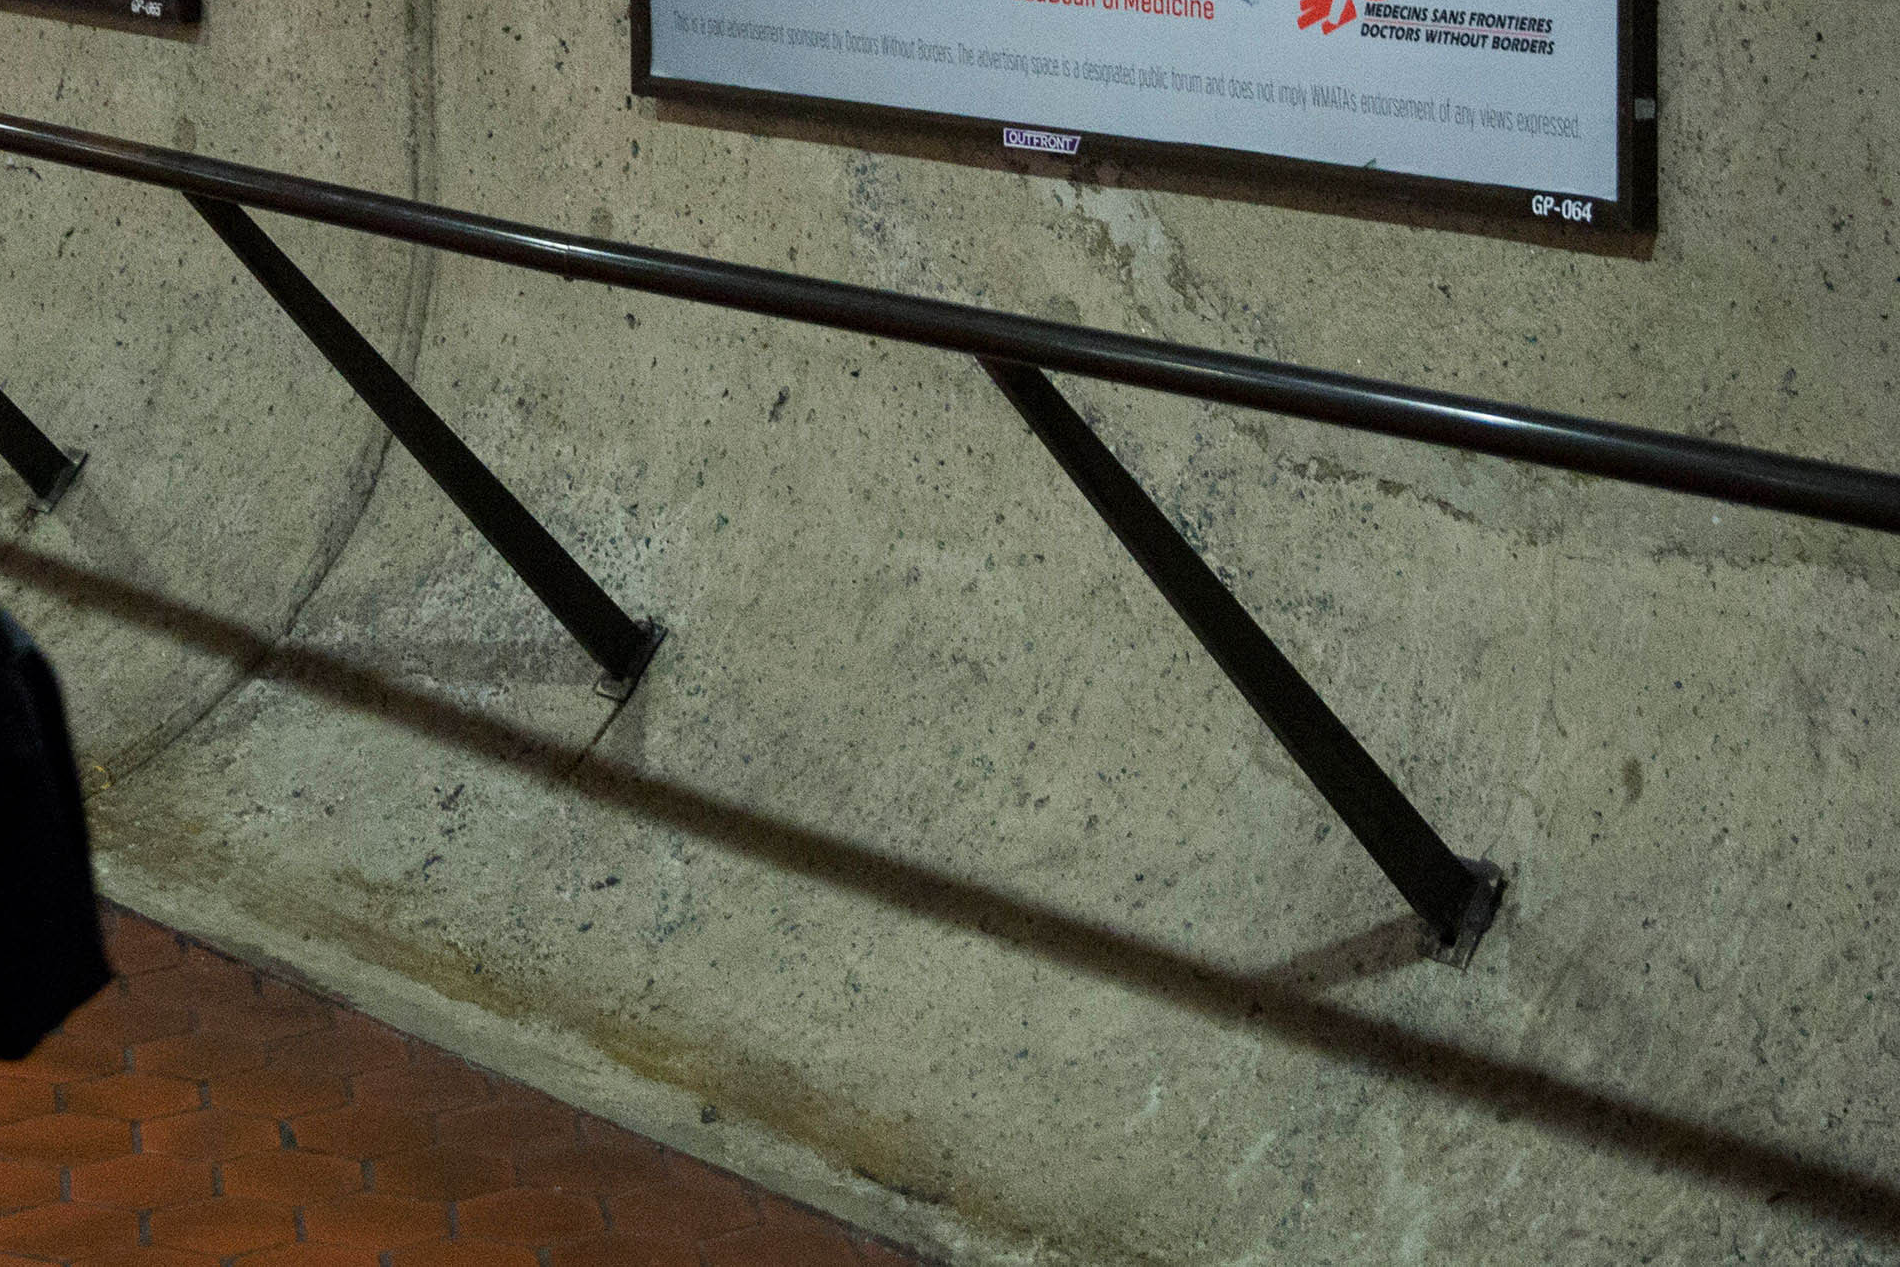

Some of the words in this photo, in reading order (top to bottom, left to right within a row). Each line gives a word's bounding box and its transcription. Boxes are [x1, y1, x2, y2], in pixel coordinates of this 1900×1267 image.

[1364, 2, 1429, 23] MEDECINS
[1431, 8, 1465, 27] SANS
[1468, 10, 1553, 34] FRONTIERES
[1360, 23, 1421, 42] DOCTORS
[1425, 28, 1489, 50] WITHOUT
[1491, 32, 1555, 56] BORDERS
[727, 20, 784, 44] advertisement
[787, 27, 830, 51] sponsored
[832, 29, 843, 54] by
[845, 30, 879, 55] Doctors
[880, 35, 915, 60] Without
[957, 42, 974, 66] The
[977, 46, 1028, 76] advertising
[1031, 55, 1059, 78] space
[1062, 55, 1071, 78] is
[1082, 57, 1136, 87] designated
[1138, 65, 1168, 91] public
[1170, 66, 1202, 93] forum
[1205, 72, 1225, 97] and
[1228, 76, 1254, 100] does
[1256, 79, 1275, 103] not
[1278, 81, 1307, 111] imply
[1360, 93, 1437, 122] endorsement
[1439, 97, 1451, 123] of
[1454, 104, 1475, 131] any
[1479, 104, 1513, 131] views
[1008, 130, 1074, 152] OUTFRONT
[1531, 194, 1593, 223] GP-064
